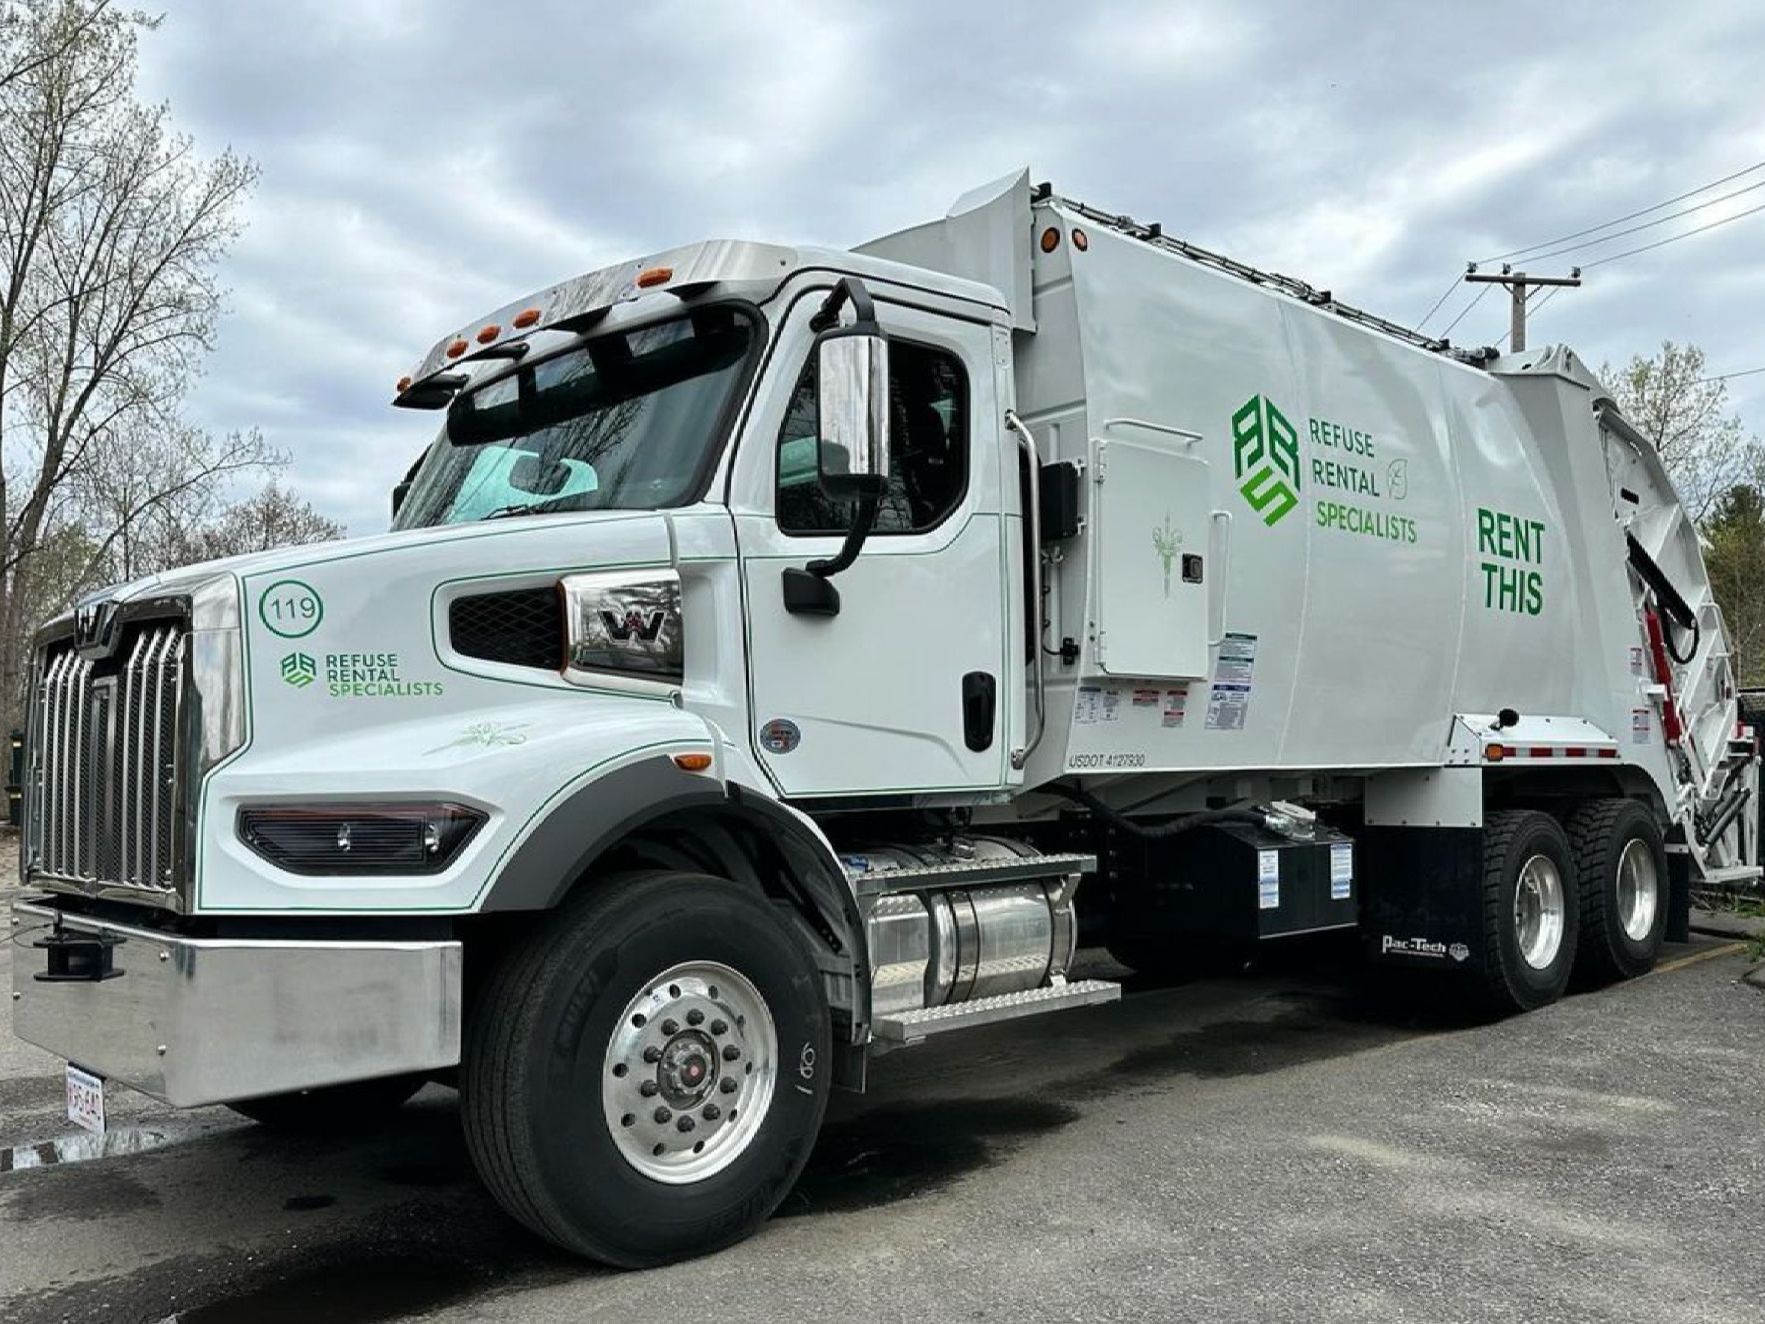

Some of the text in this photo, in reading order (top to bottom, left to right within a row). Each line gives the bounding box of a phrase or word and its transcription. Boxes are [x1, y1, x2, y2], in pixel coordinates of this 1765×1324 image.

[1309, 417, 1375, 458] REFUSE
[1312, 458, 1380, 497] RENTAL
[1317, 500, 1417, 544] SPECIALISTS
[1478, 507, 1545, 565] RENT
[1481, 562, 1543, 616] THIS
[271, 596, 316, 620] 119
[325, 653, 399, 668] REFUSE
[326, 668, 401, 683] RENTAL
[329, 682, 444, 697] SPECIALISTS
[1068, 753, 1104, 768] USDOT
[1382, 935, 1447, 954] Pac-Tech
